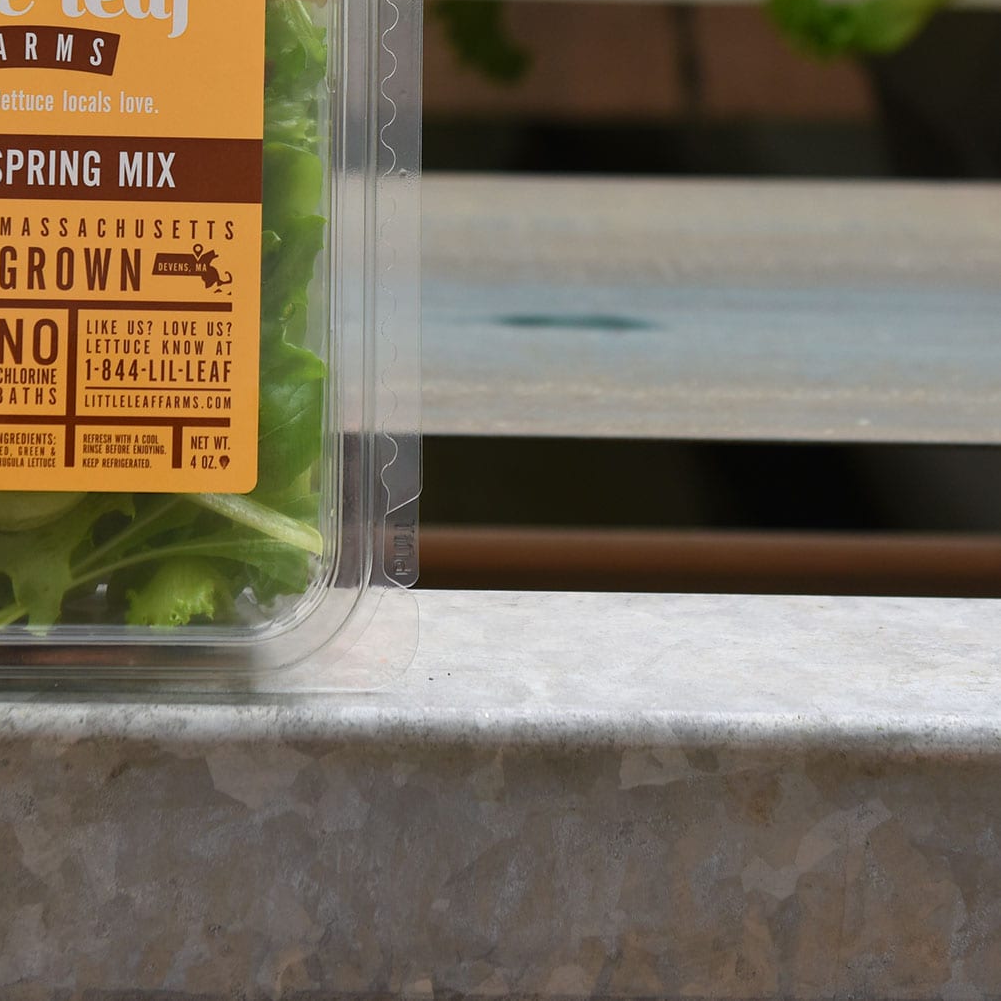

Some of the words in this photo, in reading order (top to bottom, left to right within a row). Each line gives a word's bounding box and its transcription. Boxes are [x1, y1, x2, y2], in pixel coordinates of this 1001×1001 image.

[63, 90, 111, 113] locals
[120, 91, 159, 114] love.
[118, 151, 176, 188] MIX
[0, 217, 234, 240] MASSACHUSETTS
[157, 262, 191, 273] DEVENS,
[195, 263, 207, 272] MA
[86, 319, 118, 335] LIKE
[127, 320, 153, 336] US?
[163, 321, 197, 336] LOVE
[207, 321, 233, 337] US?
[86, 339, 151, 354] LETTUCE
[162, 339, 205, 355] KNOW
[215, 341, 233, 356] AT
[84, 358, 232, 383] 1-844-LIL-LEAF
[84, 395, 232, 410] LITTLELEAFFARMS.COM
[83, 433, 112, 444] REFRESH
[115, 434, 132, 444] WITH
[134, 434, 139, 444] A
[142, 435, 159, 445] COOL
[190, 436, 209, 450] NET
[214, 436, 231, 451] WT.
[18, 446, 45, 456] GREEN
[50, 447, 56, 457] &
[82, 444, 102, 454] RINSE
[105, 445, 130, 455] BEFORE
[133, 445, 167, 456] ENJOYING.
[27, 457, 56, 468] LETTUCE
[82, 458, 99, 468] KEEP
[102, 458, 152, 469] REFRIGERATED.
[190, 455, 196, 469] 4
[201, 455, 217, 469] OZ.
